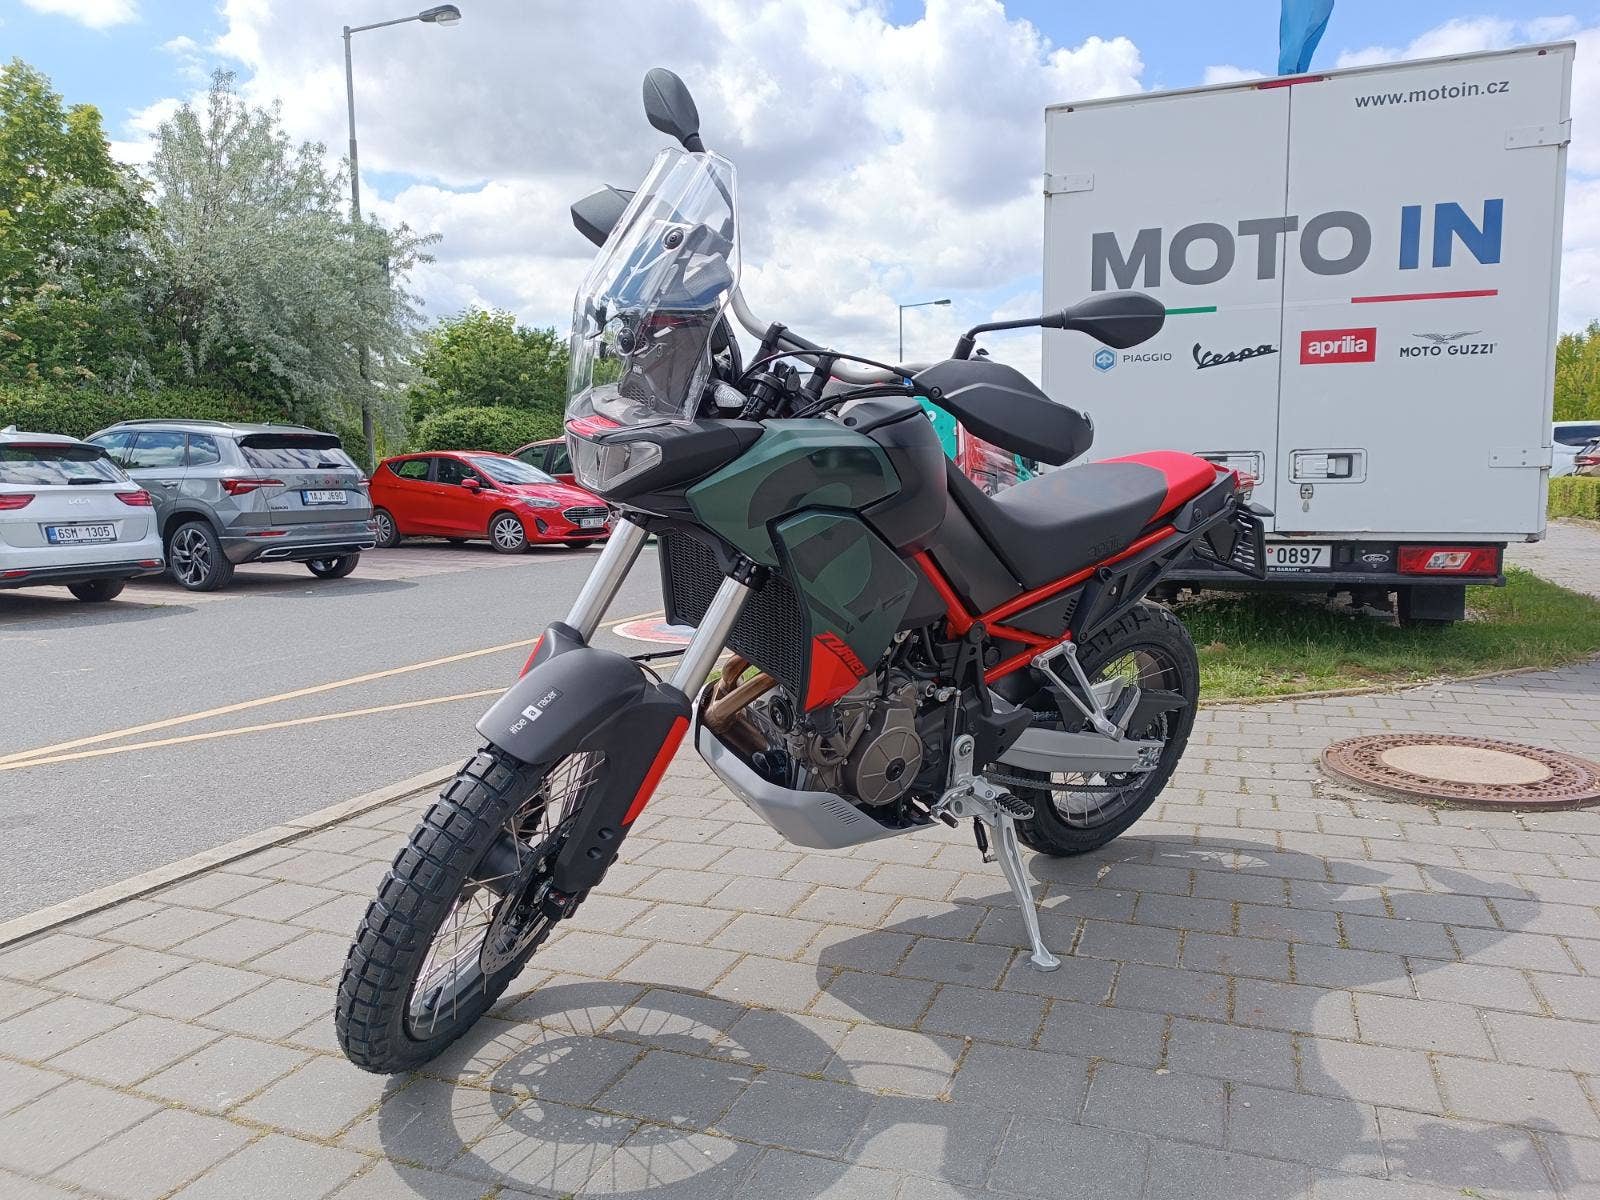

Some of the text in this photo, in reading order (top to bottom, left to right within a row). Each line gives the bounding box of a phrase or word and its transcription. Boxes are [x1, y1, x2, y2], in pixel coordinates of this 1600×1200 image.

[1355, 80, 1510, 108] www.motoin.cz
[1091, 198, 1504, 291] MOTO IN
[1123, 352, 1172, 363] PIAGGIO
[1192, 342, 1279, 370] Vespa
[1308, 335, 1368, 358] aprilia
[1400, 343, 1494, 358] MOTO GUZZI
[58, 526, 110, 539] 6SM 1305
[1276, 547, 1322, 564] 0897
[509, 718, 527, 735] #be
[537, 690, 557, 708] racer
